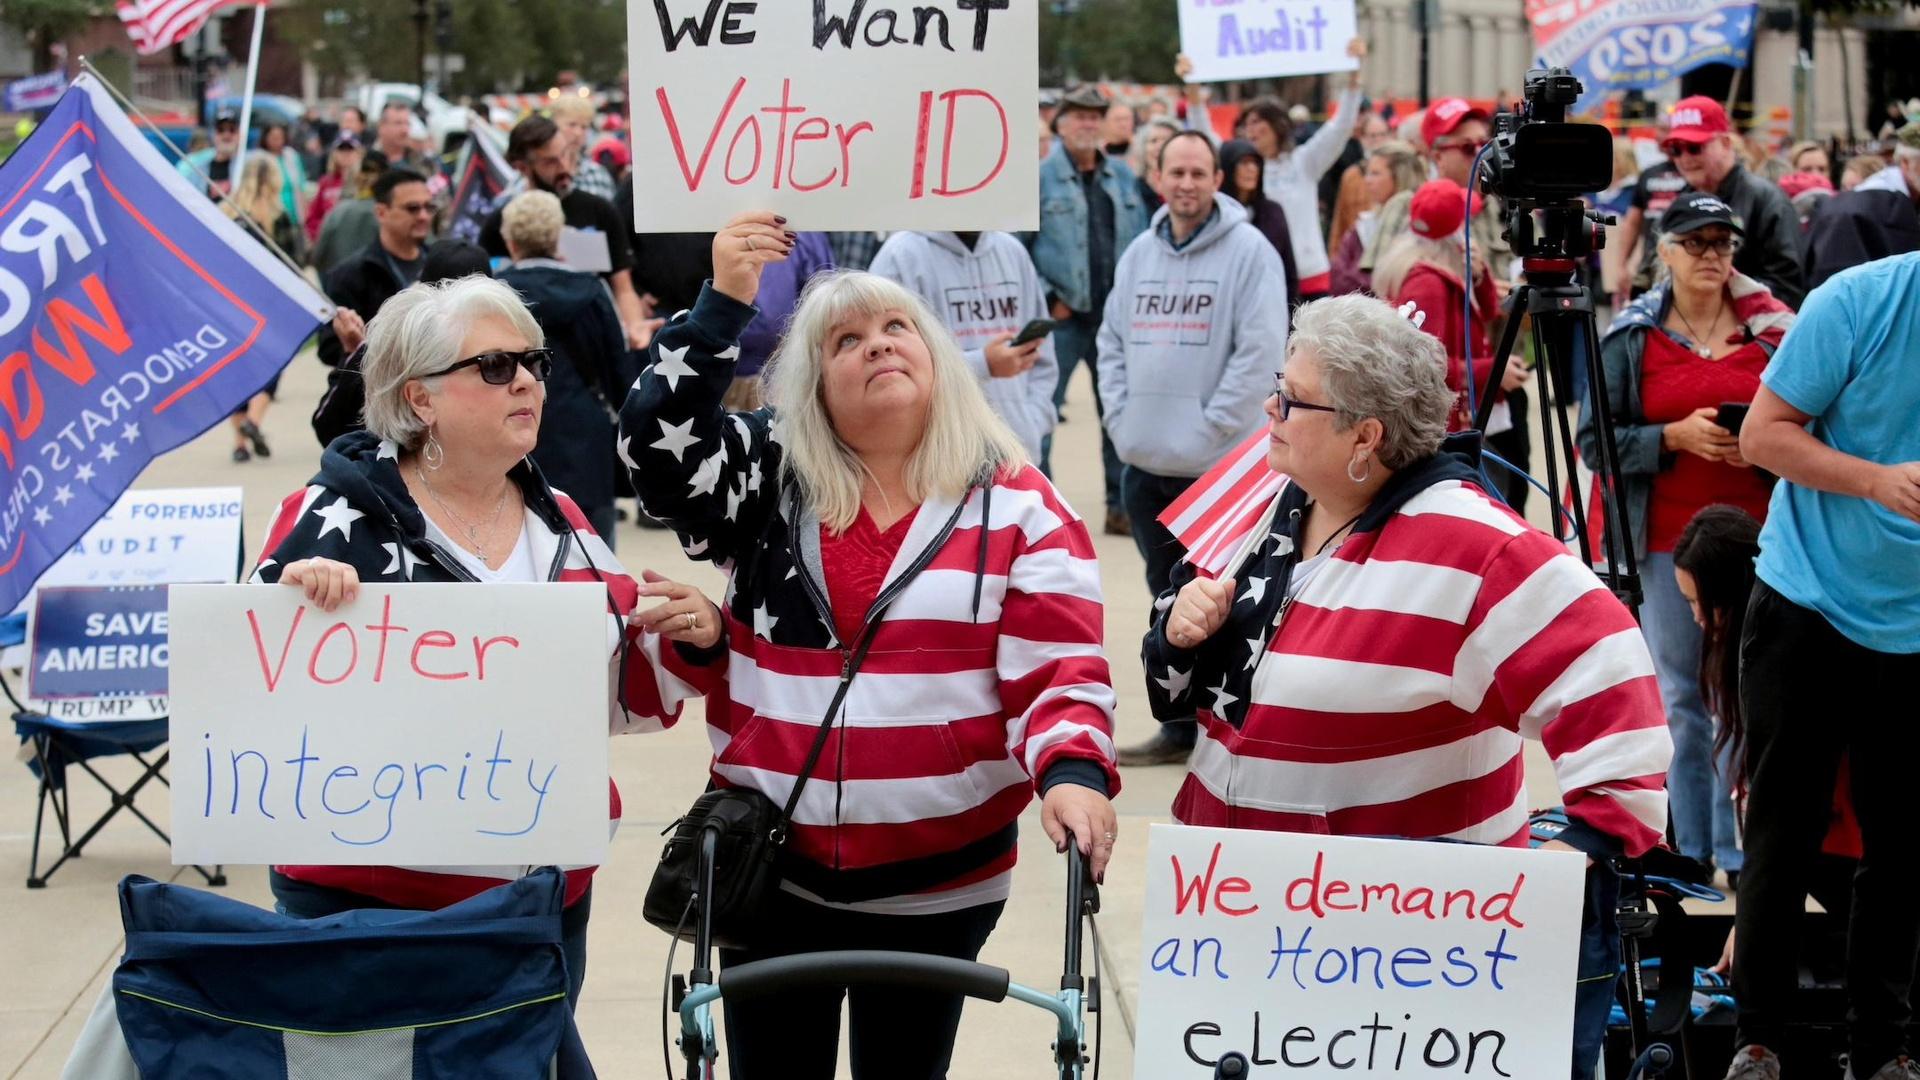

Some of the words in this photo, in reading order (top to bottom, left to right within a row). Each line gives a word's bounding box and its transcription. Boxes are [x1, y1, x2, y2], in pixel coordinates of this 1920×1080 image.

[653, 0, 757, 52] WE
[1217, 6, 1328, 57] Audit
[656, 76, 873, 192] Voter
[909, 88, 1009, 199] ID
[1135, 294, 1213, 315] TRUMP
[132, 502, 240, 520] FORENSIC
[72, 535, 185, 555] AUDIT
[85, 612, 169, 637] SAVE
[247, 594, 519, 692] Voter
[41, 699, 133, 718] TRUMP
[205, 724, 557, 846] integrity
[1171, 842, 1259, 917] We
[1285, 851, 1525, 928] demand
[1151, 936, 1229, 980] an
[1266, 926, 1518, 990] Honest
